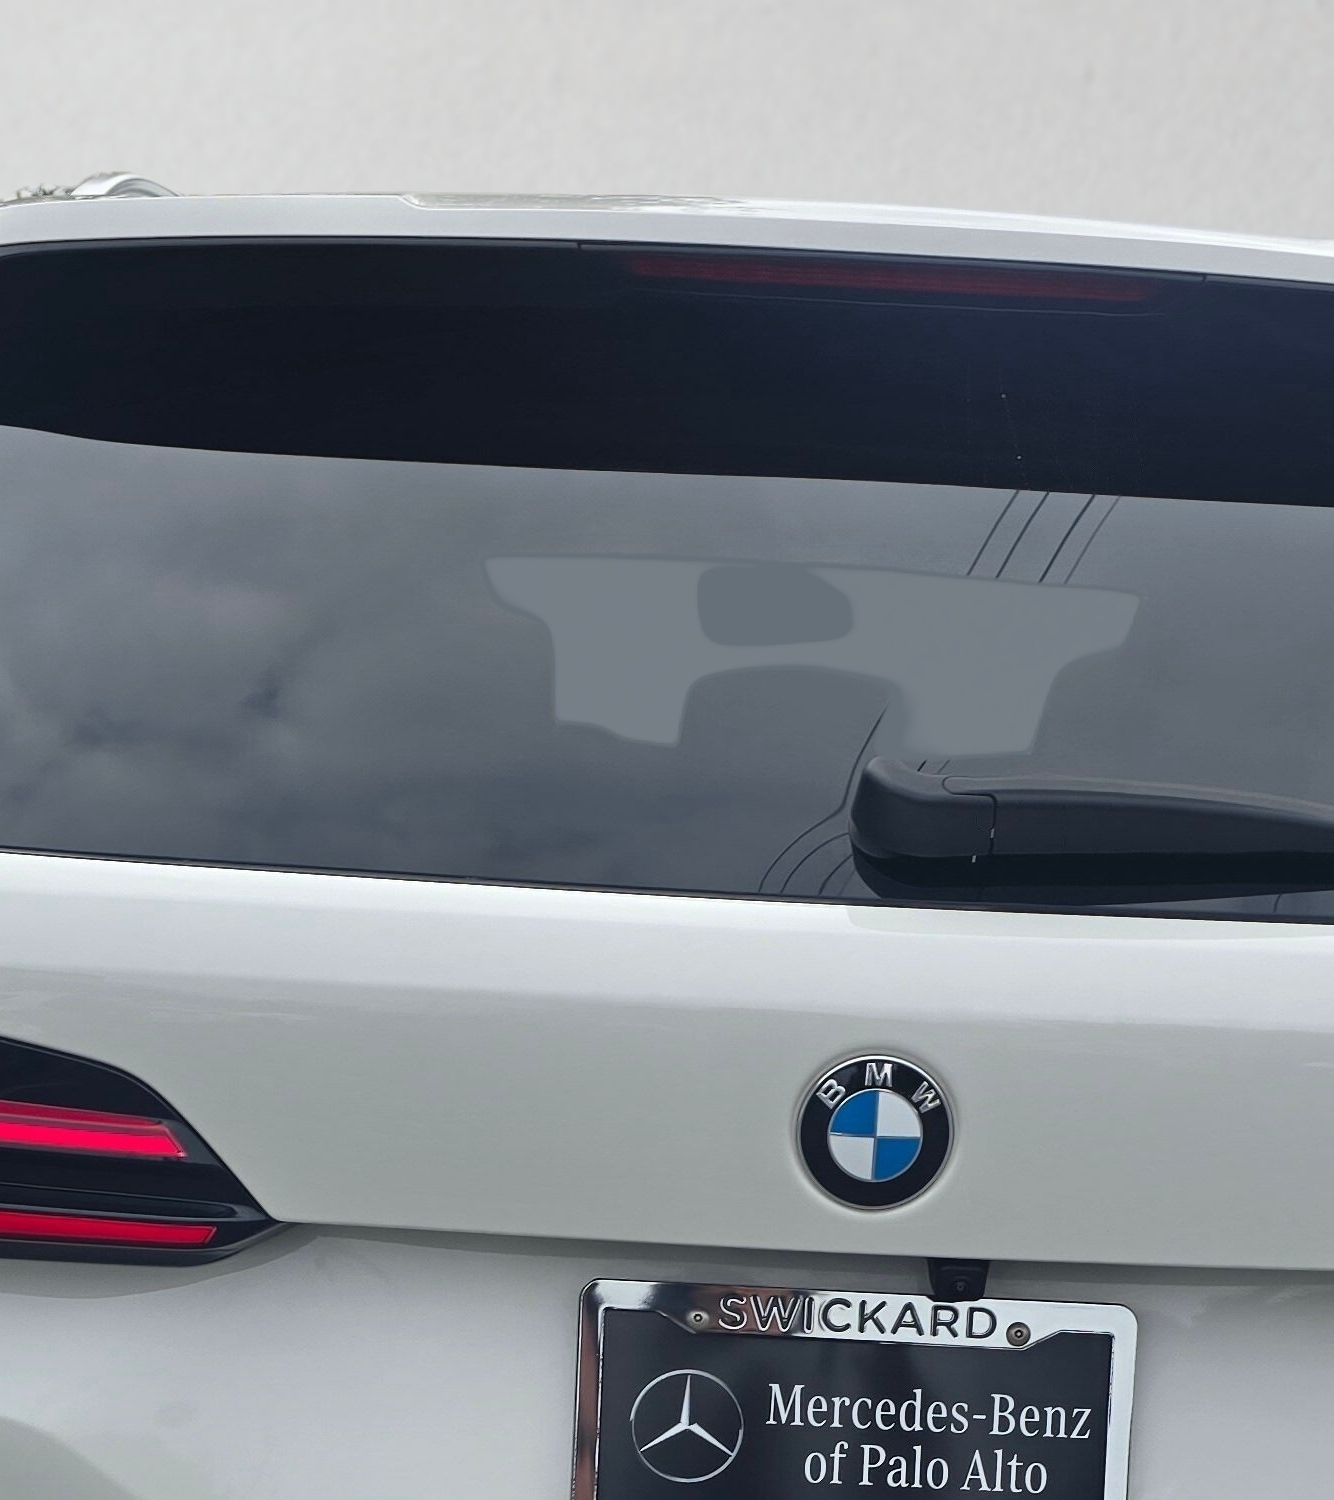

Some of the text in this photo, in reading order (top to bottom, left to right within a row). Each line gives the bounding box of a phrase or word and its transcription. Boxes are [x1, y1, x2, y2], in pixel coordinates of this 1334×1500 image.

[816, 1062, 941, 1114] BMW
[718, 1294, 998, 1339] SWICKARD
[765, 1383, 1092, 1439] Mercedes-Benz
[803, 1440, 1048, 1494] of Palo Alto
